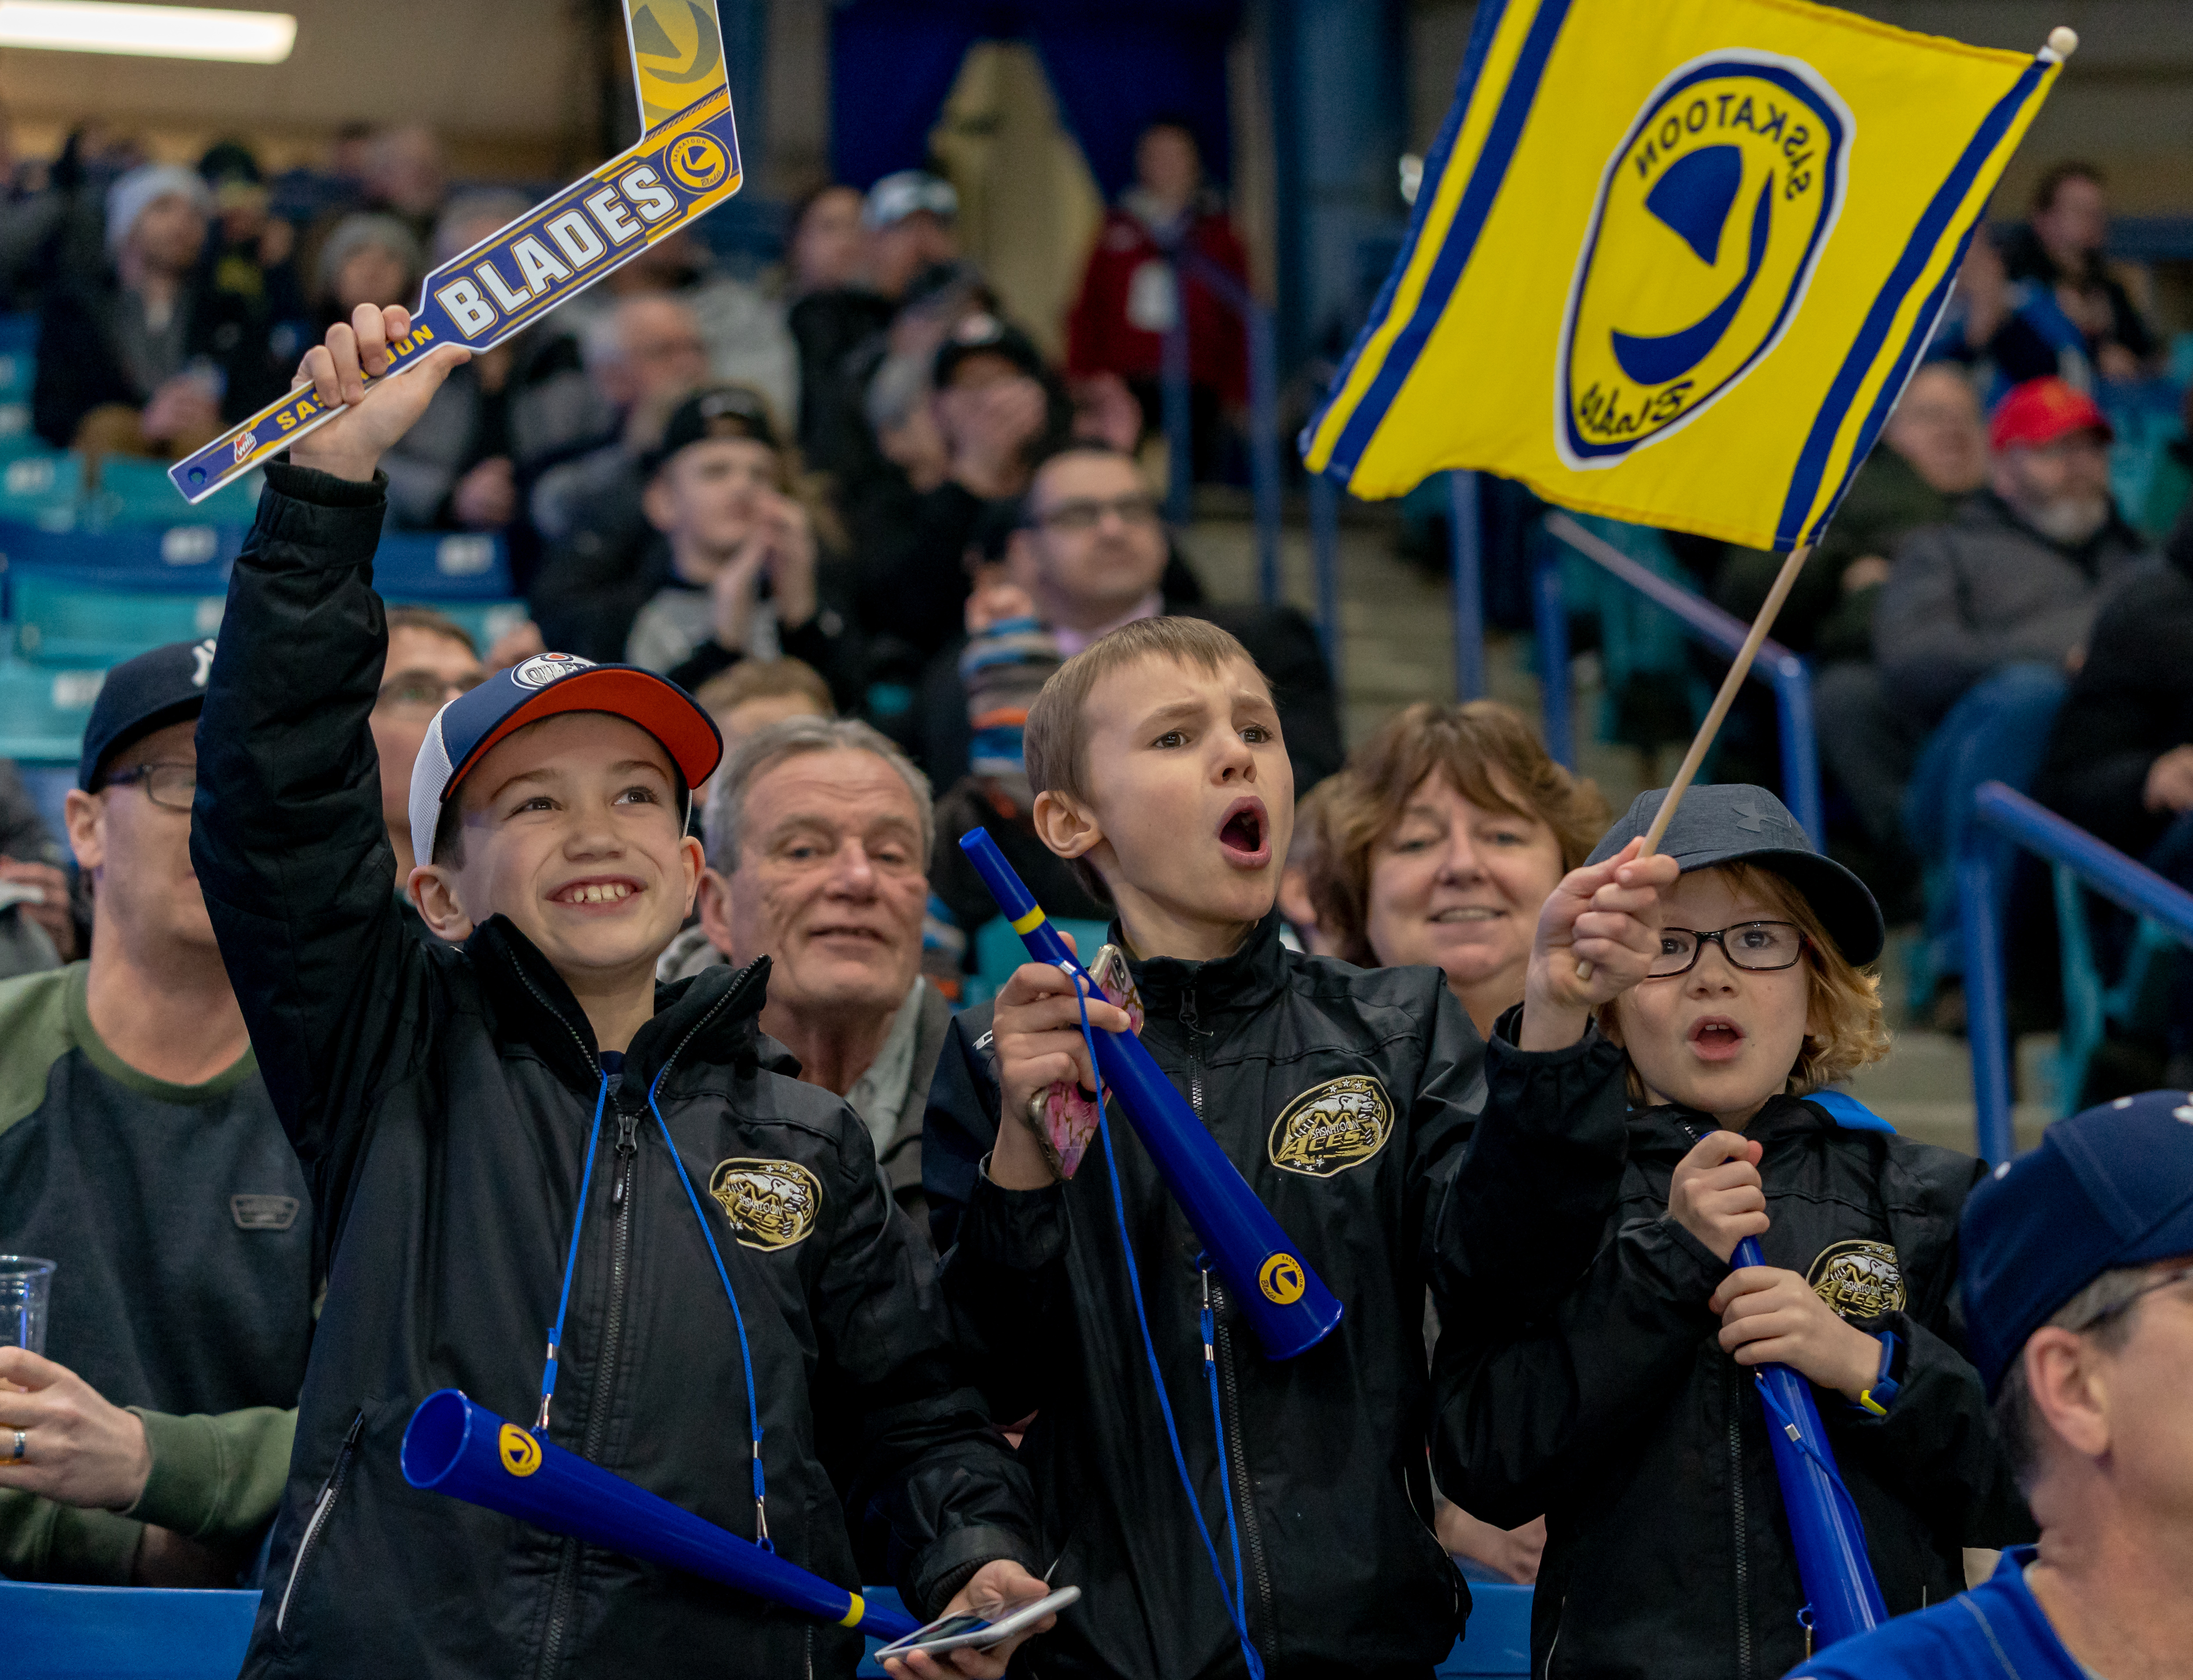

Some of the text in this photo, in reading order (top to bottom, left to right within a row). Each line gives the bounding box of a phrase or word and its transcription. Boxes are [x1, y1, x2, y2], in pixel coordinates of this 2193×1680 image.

[673, 138, 707, 162] SASKATOON
[434, 165, 678, 339] BLADES
[525, 662, 597, 684] OILER
[1310, 1120, 1360, 1139] SASKATOON
[1276, 1129, 1366, 1161] ACES
[739, 1193, 782, 1216] SASKATOON
[1281, 1255, 1303, 1288] SASKATOON
[1842, 1275, 1880, 1297] SASKATOON
